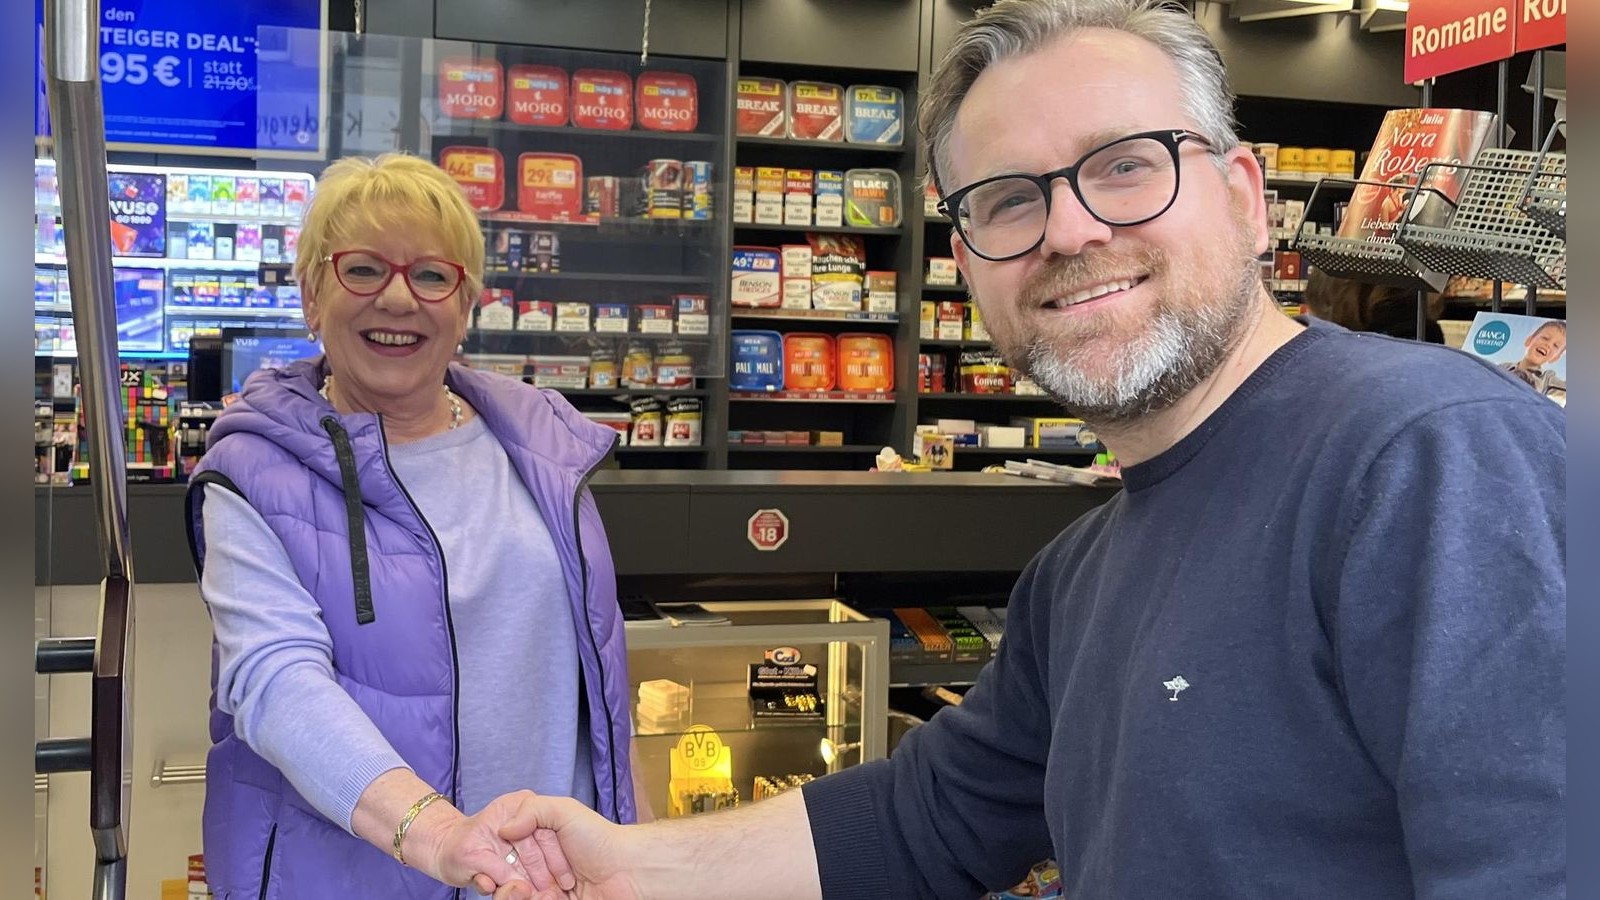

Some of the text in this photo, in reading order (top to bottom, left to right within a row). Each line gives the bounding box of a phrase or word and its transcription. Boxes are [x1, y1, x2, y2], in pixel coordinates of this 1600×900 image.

[105, 7, 135, 22] den
[1411, 7, 1507, 58] Romane
[203, 60, 243, 75] statt
[447, 93, 497, 107] MORO
[737, 99, 780, 112] BREAK
[515, 101, 563, 114] MORO
[578, 104, 626, 120] MORO
[644, 107, 690, 121] MORO
[796, 103, 838, 116] BREAK
[855, 107, 896, 119] BREAK
[1420, 113, 1444, 126] Julia
[1388, 126, 1438, 149] Nora
[787, 181, 811, 189] BREAK
[818, 182, 842, 190] BREAK
[853, 180, 889, 190] BLACK
[853, 189, 886, 198] HAWK
[1366, 231, 1397, 245] durch
[812, 253, 843, 265] Rauchen
[812, 263, 851, 274] Ihre Lunge
[739, 279, 774, 289] BENSON
[1478, 329, 1506, 341] BIANCA
[1476, 338, 1504, 348] WEEKEND
[736, 362, 774, 374] PALL MALL
[811, 363, 826, 374] MALL
[867, 363, 883, 374] MALL
[758, 527, 777, 543] 18
[685, 732, 716, 759] BVB
